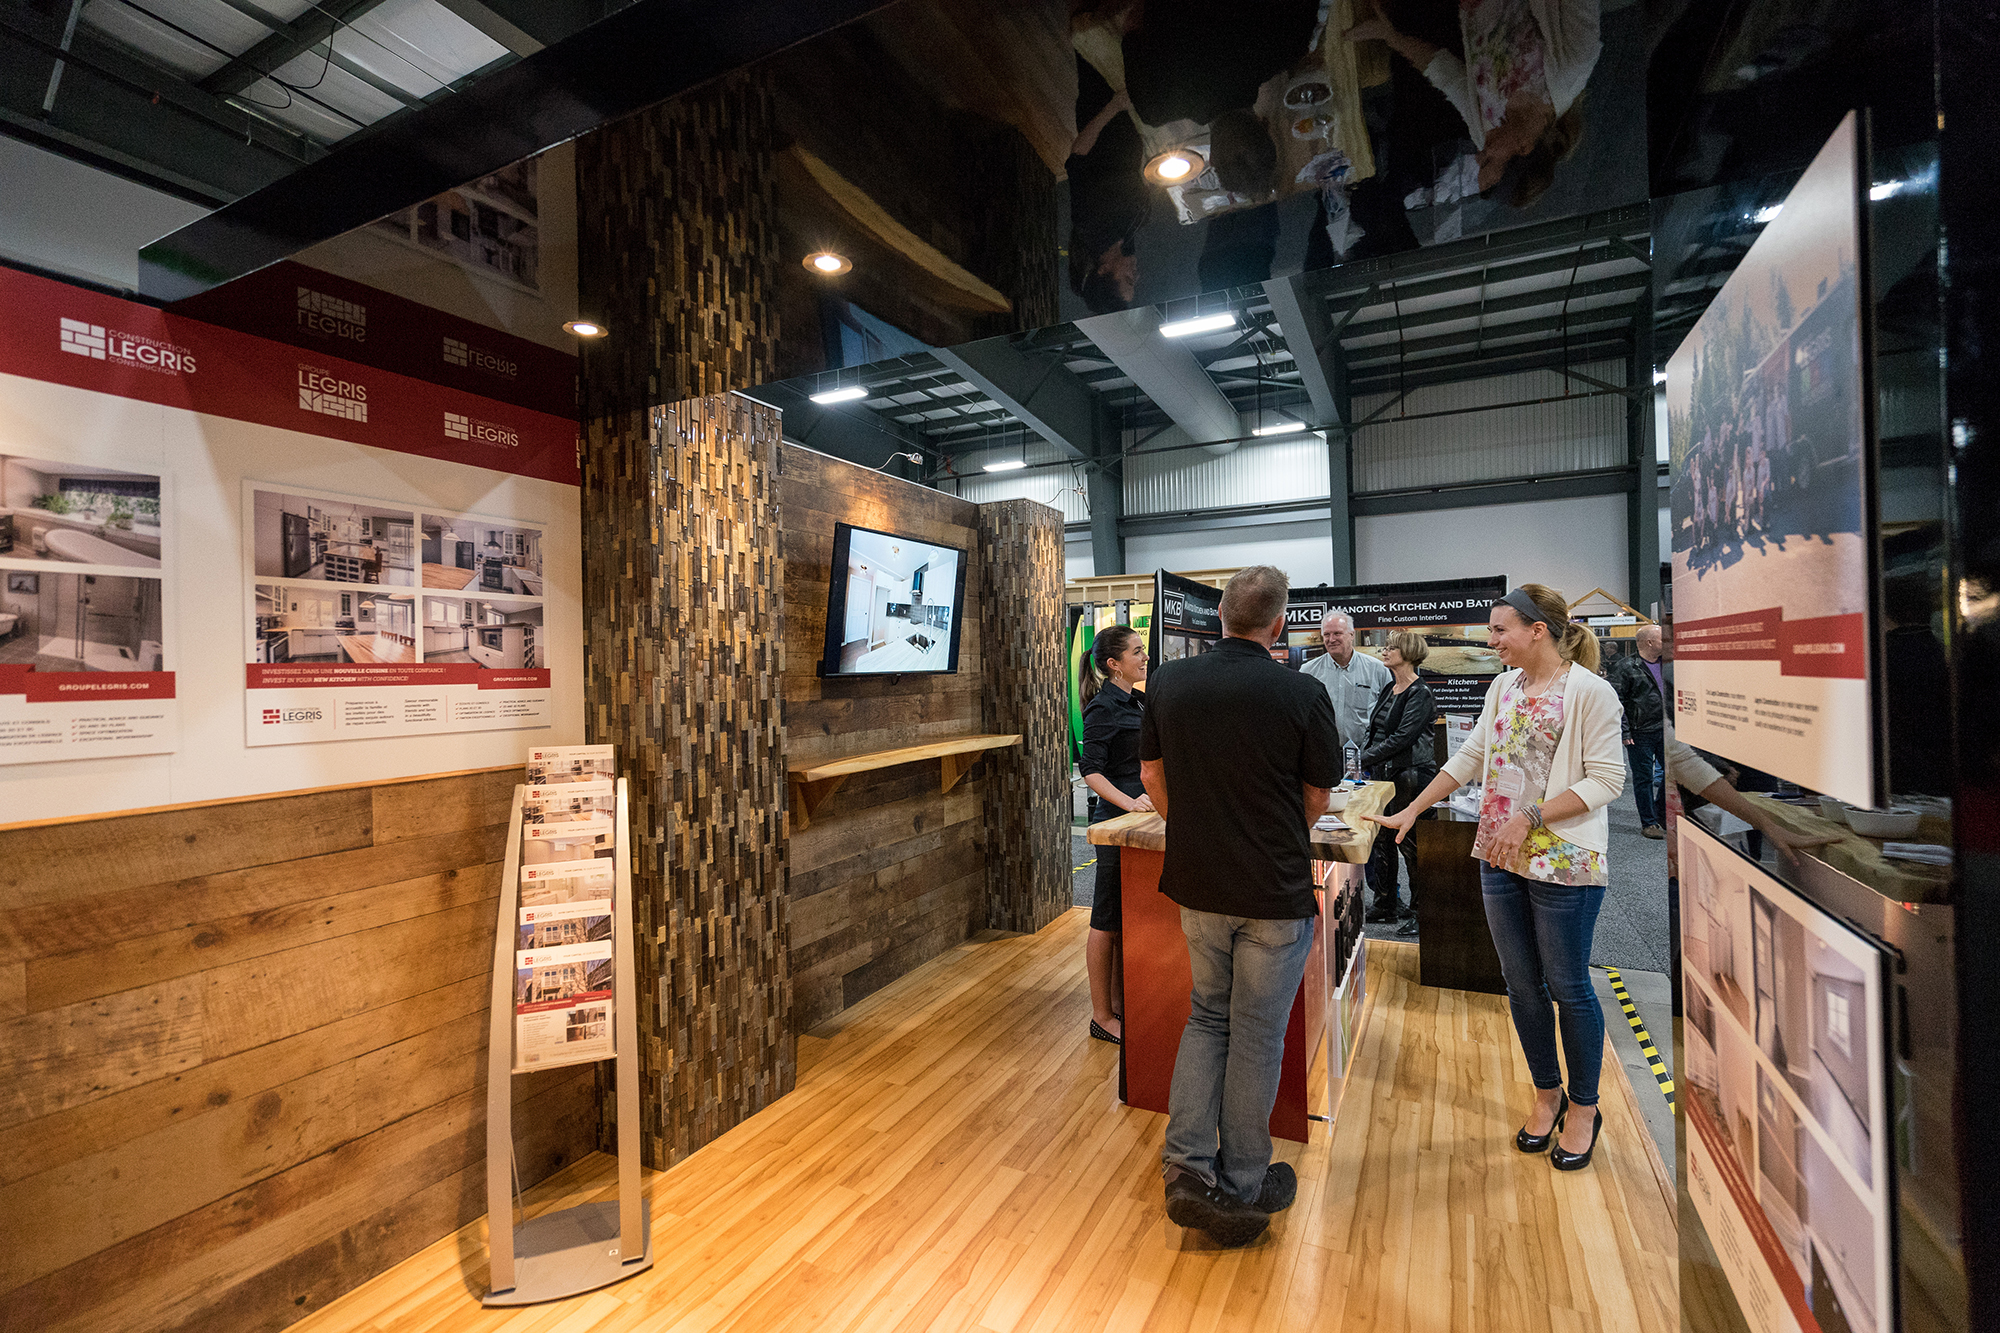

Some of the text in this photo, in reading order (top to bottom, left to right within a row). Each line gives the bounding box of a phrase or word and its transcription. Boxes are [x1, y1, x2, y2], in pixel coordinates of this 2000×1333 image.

[108, 329, 191, 354] CONSTRUCTION
[108, 338, 196, 374] LEGRIS
[109, 356, 178, 376] CONSTRUCTION
[298, 363, 330, 376] GROUPE
[298, 370, 367, 401] LEGRIS
[470, 424, 518, 446] LEGRIS
[1164, 598, 1182, 616] MKB
[1286, 608, 1322, 622] MKB
[1332, 605, 1387, 614] MANOTICK
[1388, 602, 1436, 612] KITCHEN
[1439, 600, 1463, 609] AND
[1133, 616, 1152, 628] ME
[58, 683, 149, 691] GROUPELEGRIS.COM
[283, 711, 322, 721] LEGRIS
